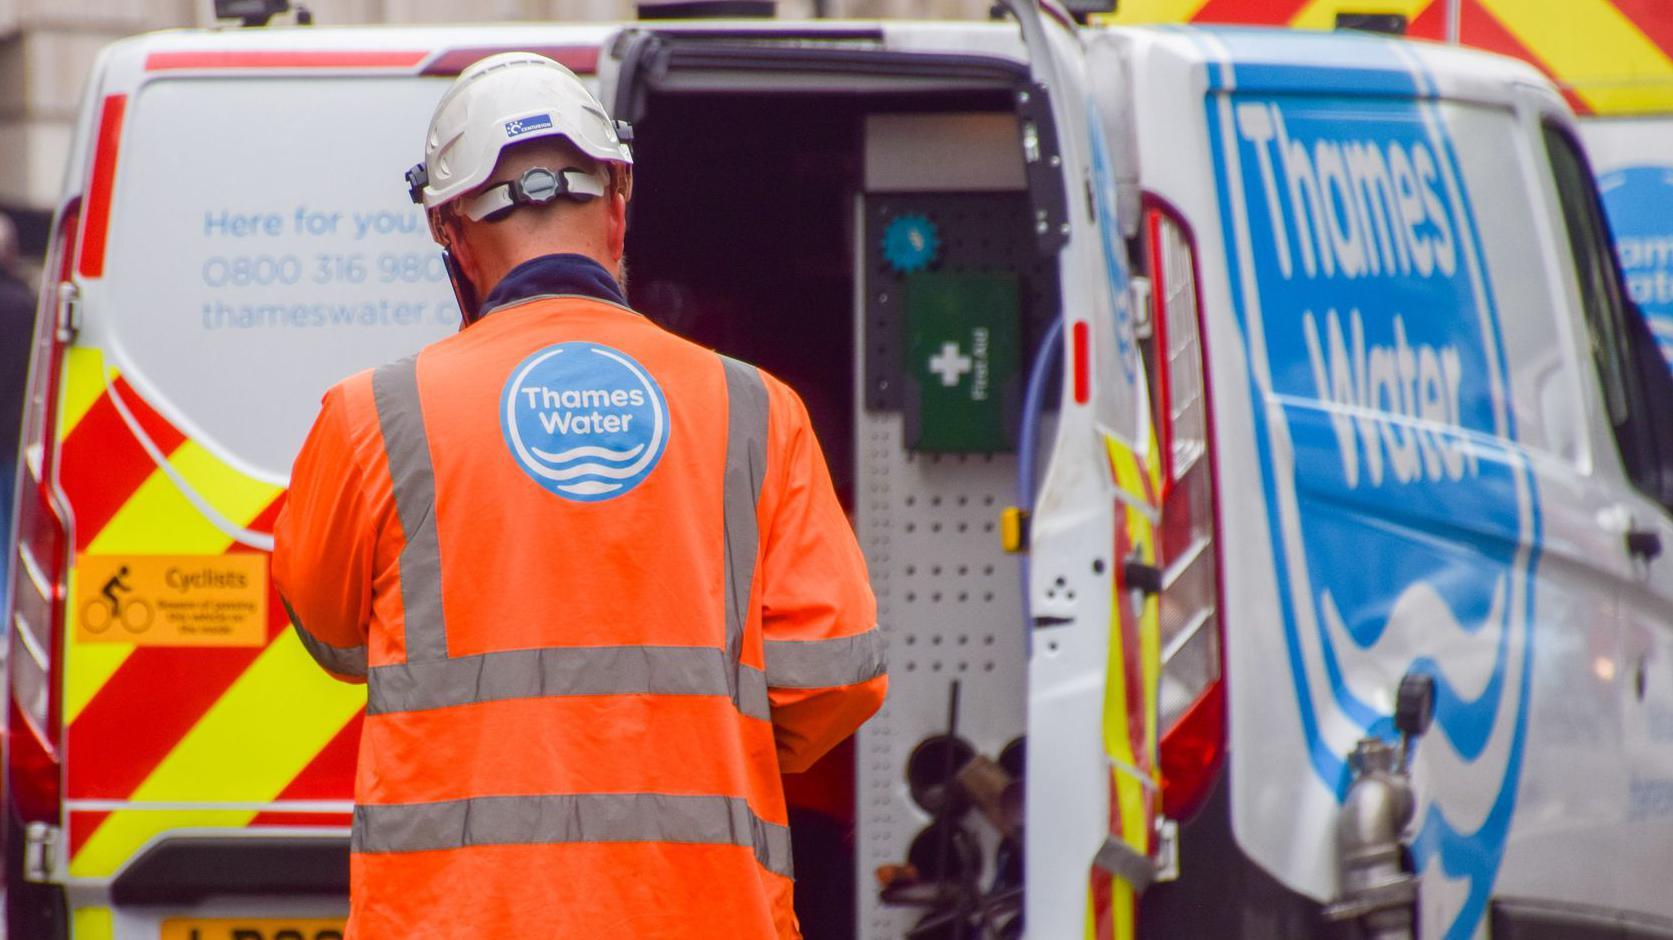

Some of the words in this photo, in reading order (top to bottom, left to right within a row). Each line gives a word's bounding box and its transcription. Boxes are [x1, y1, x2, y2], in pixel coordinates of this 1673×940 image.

[1236, 102, 1457, 279] Thames
[204, 209, 284, 237] Here
[294, 206, 343, 235] for
[202, 255, 303, 287] 0800
[312, 253, 368, 284] 316
[972, 327, 989, 358] Aid
[971, 359, 989, 400] First
[521, 386, 645, 409] Thames
[1303, 308, 1479, 489] Water
[539, 411, 633, 434] Water
[164, 566, 249, 594] Cyclists
